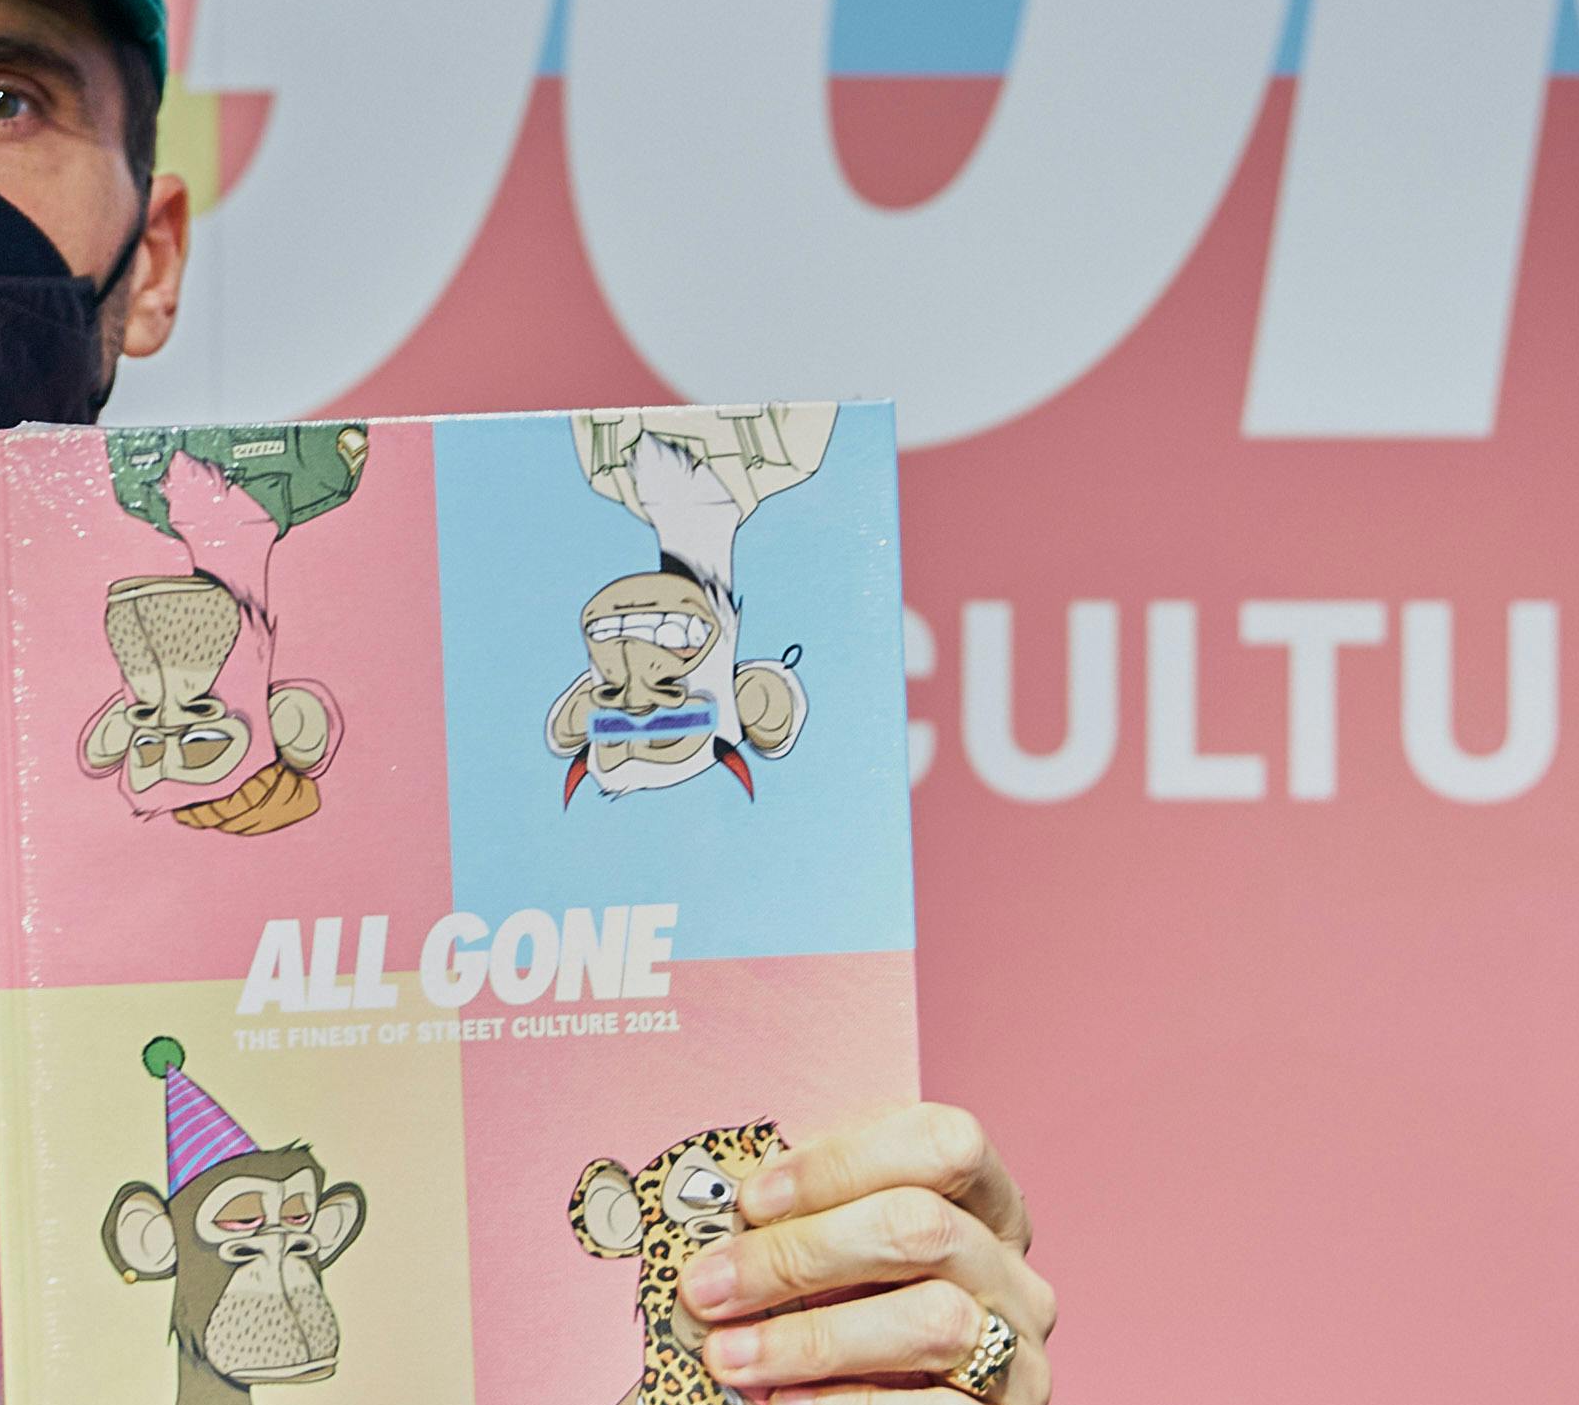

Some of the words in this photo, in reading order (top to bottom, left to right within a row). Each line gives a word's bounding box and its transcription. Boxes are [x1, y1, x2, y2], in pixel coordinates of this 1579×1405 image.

[236, 914, 398, 1015] ALL
[420, 903, 679, 1007] GONE
[234, 1028, 281, 1052] THE
[286, 1024, 371, 1048] FINEST
[378, 1022, 409, 1045] OF
[416, 1017, 504, 1043] STREET
[511, 1012, 618, 1039] CULTURE
[625, 1010, 680, 1034] 2021
